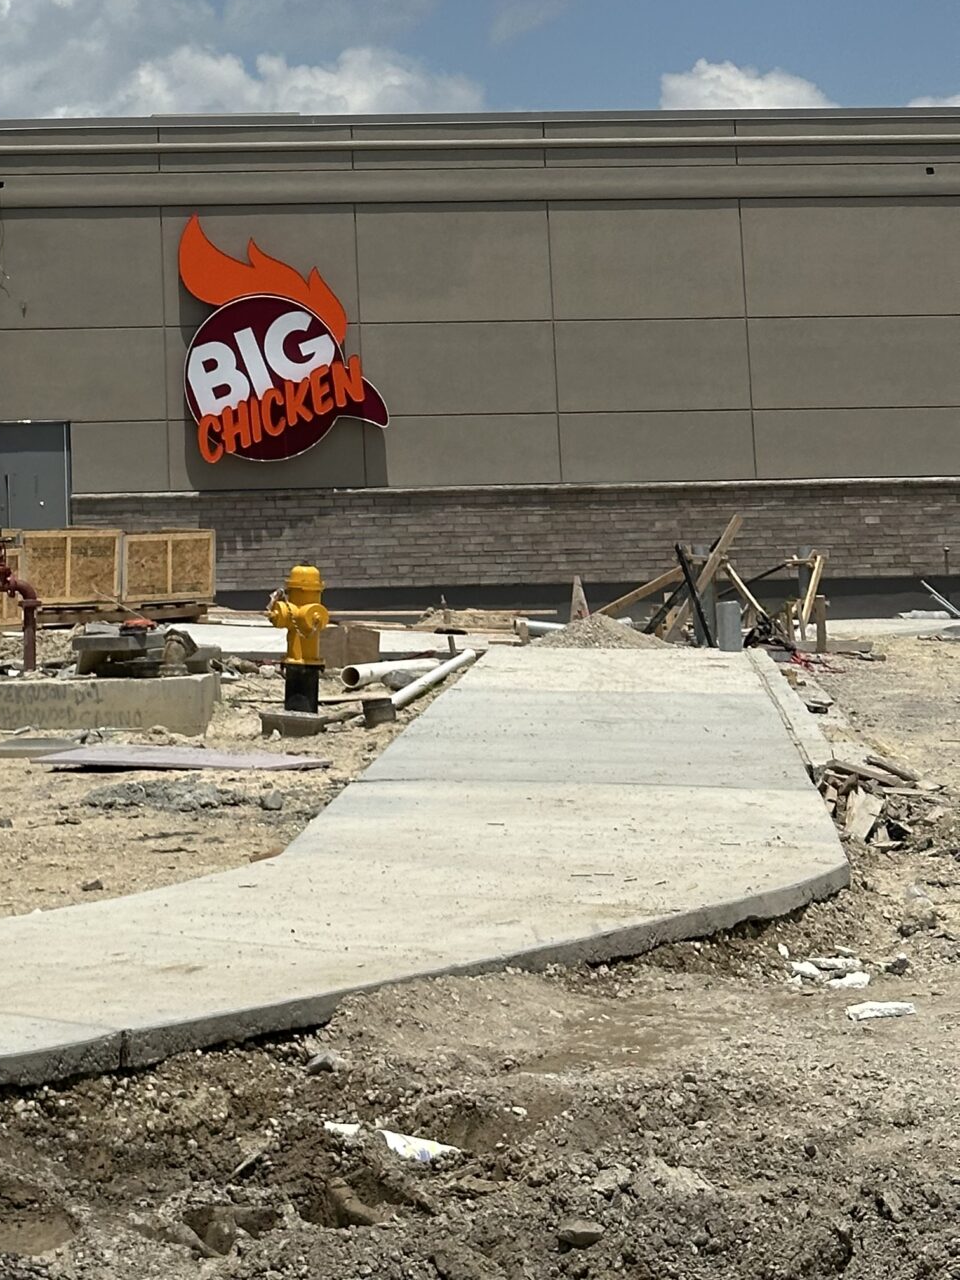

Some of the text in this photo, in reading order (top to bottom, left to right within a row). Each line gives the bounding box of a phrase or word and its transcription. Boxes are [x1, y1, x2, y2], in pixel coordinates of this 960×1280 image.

[187, 310, 335, 417] BIG
[198, 354, 365, 463] CHICKEN
[79, 708, 142, 727] CASINO
